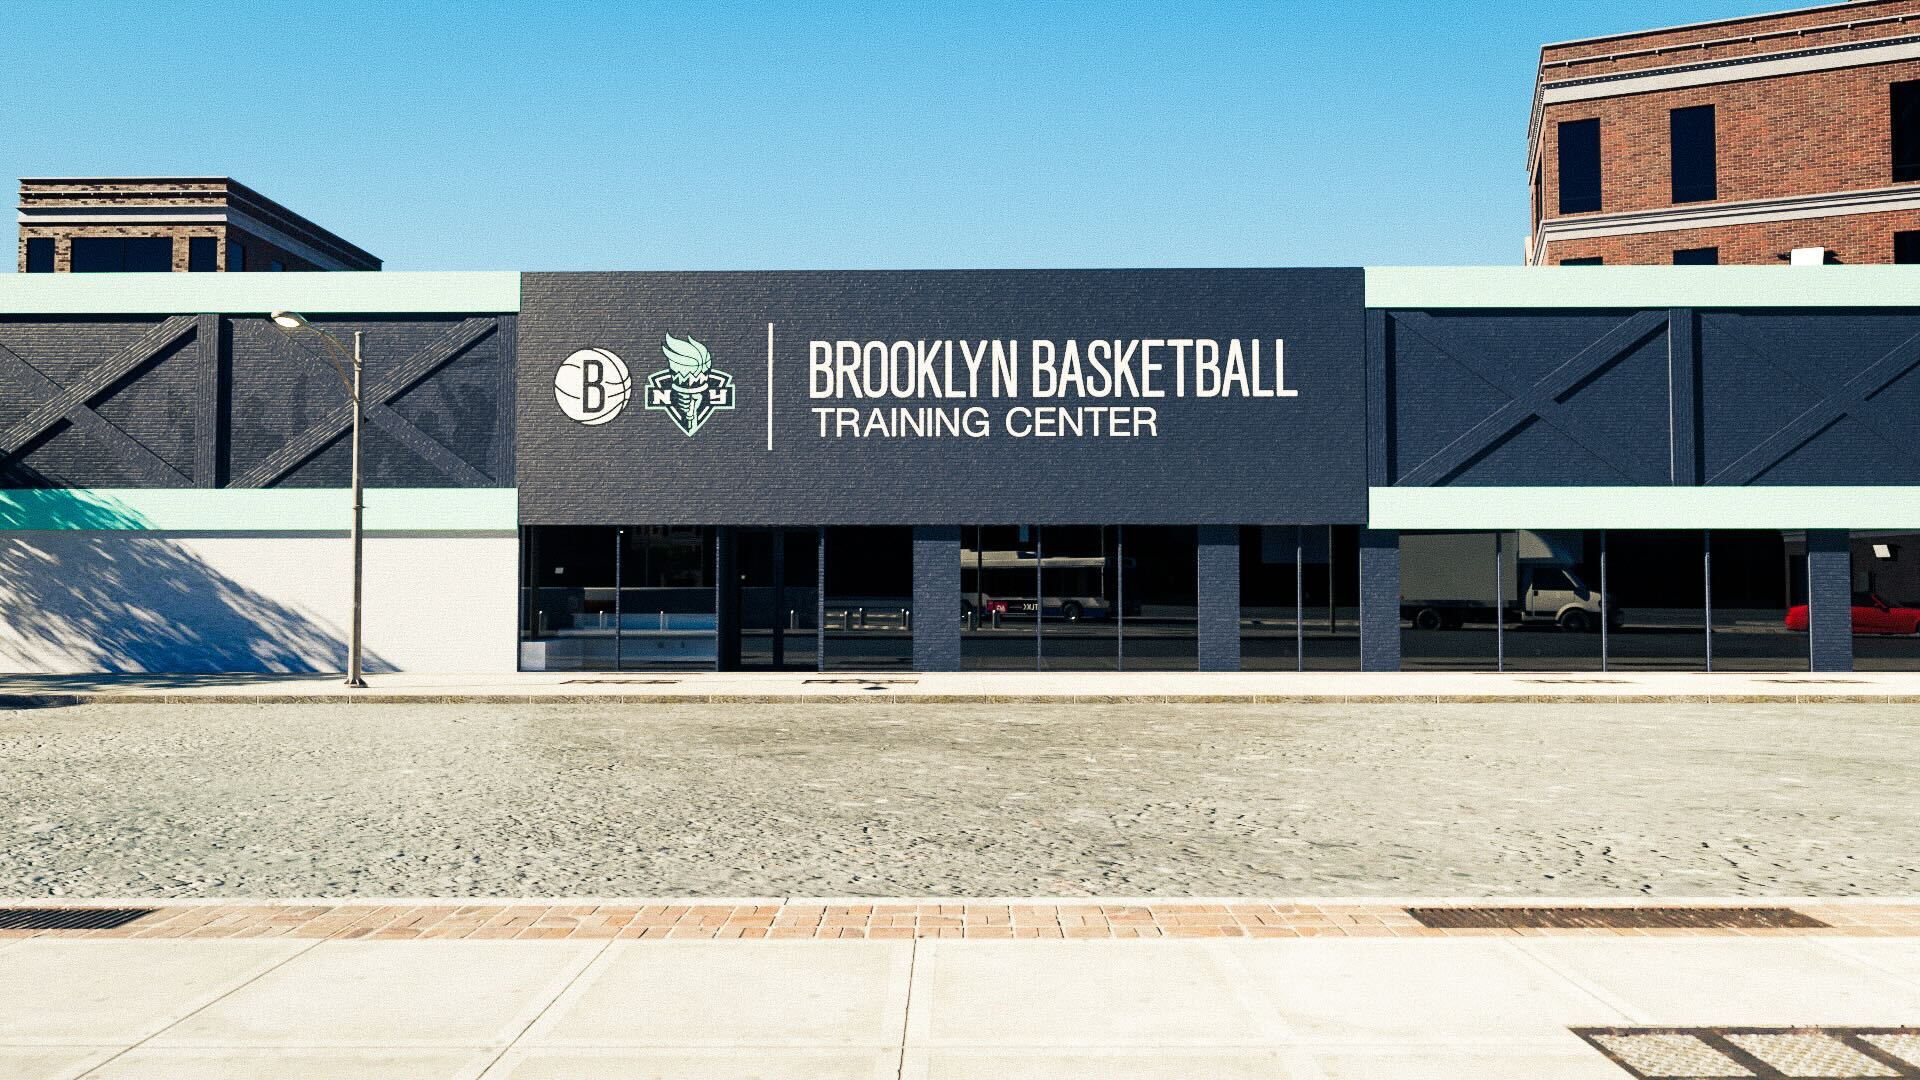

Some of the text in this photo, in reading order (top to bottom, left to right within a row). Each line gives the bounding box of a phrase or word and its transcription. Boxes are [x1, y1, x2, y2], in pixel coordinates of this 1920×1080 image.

[582, 360, 605, 413] B
[809, 338, 1299, 399] BROOKLYN BASKETBALL
[811, 406, 1158, 438] TRAINING CENTER
